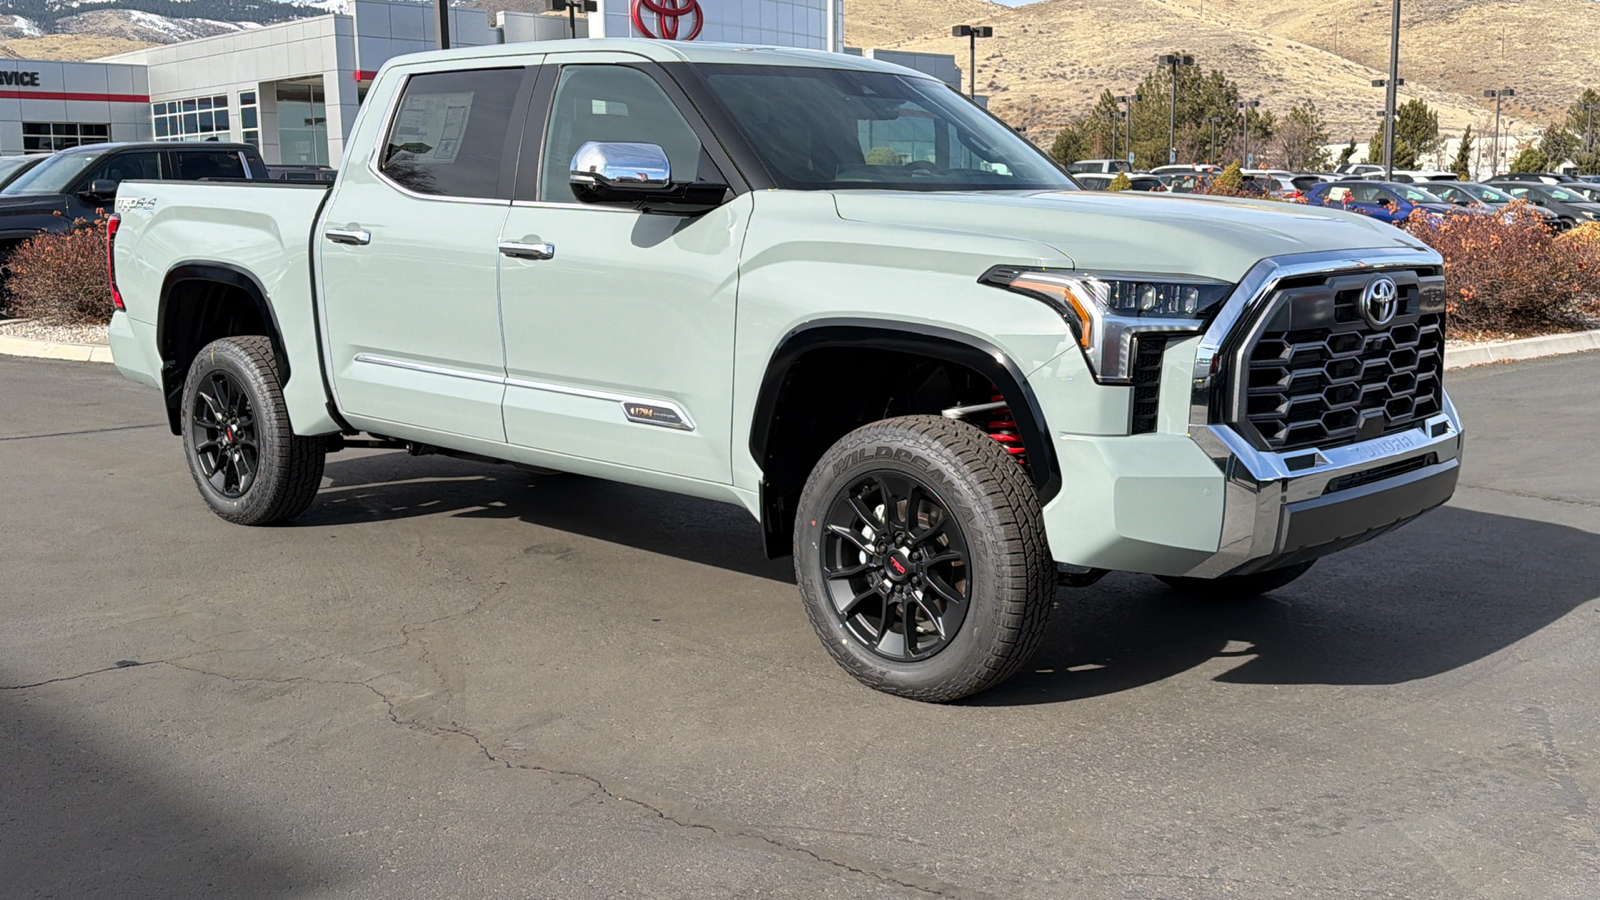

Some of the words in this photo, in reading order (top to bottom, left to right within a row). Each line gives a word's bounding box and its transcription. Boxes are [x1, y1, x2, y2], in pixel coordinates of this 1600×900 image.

[635, 406, 653, 418] 1794
[1346, 435, 1415, 457] TUNDRA
[832, 445, 963, 500] WILDPEAK
[890, 556, 906, 574] TRD
